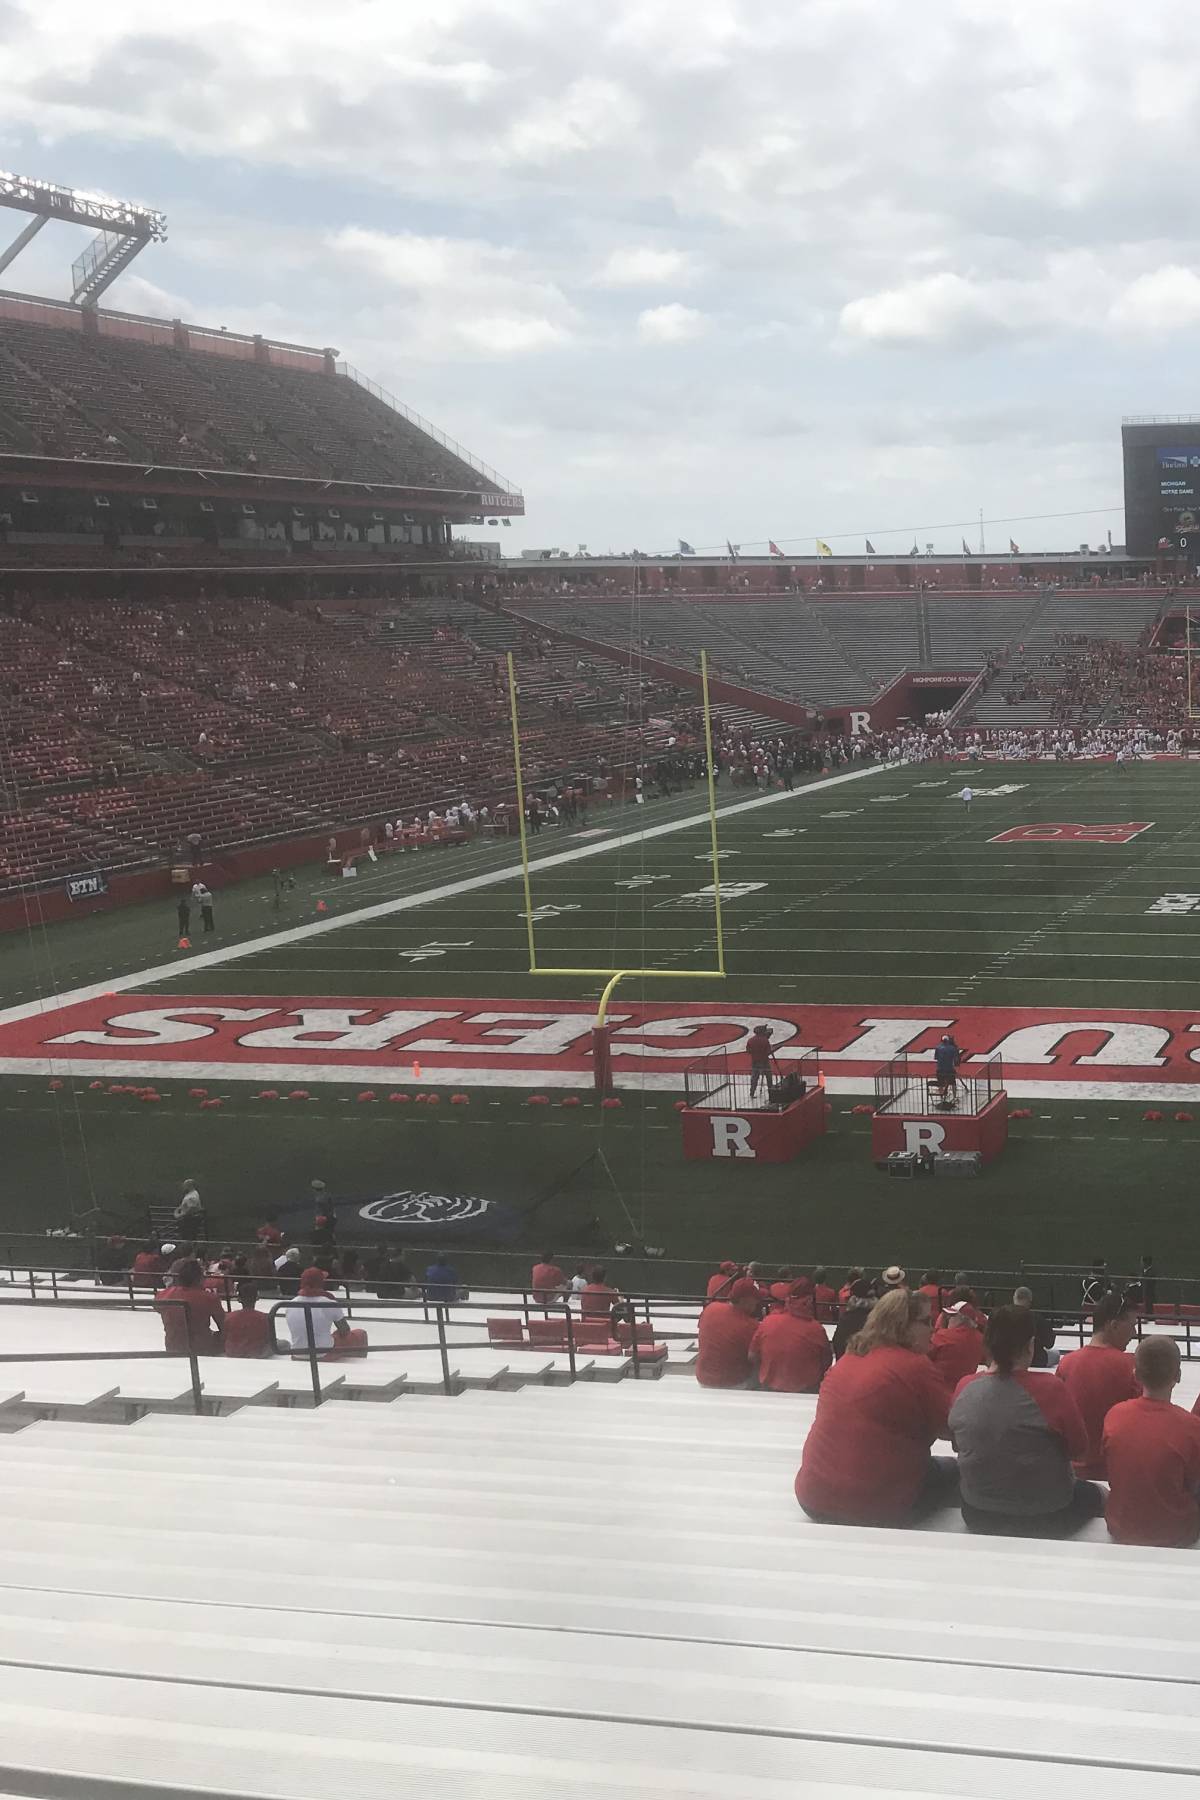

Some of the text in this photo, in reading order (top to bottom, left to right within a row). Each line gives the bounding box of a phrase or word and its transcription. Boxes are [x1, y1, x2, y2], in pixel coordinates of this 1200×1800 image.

[481, 494, 524, 508] RUTGERS
[1180, 537, 1187, 548] 0
[850, 711, 873, 736] R
[986, 822, 1156, 843] R
[70, 877, 97, 896] BTN
[710, 1116, 756, 1158] R
[902, 1121, 946, 1155] R
